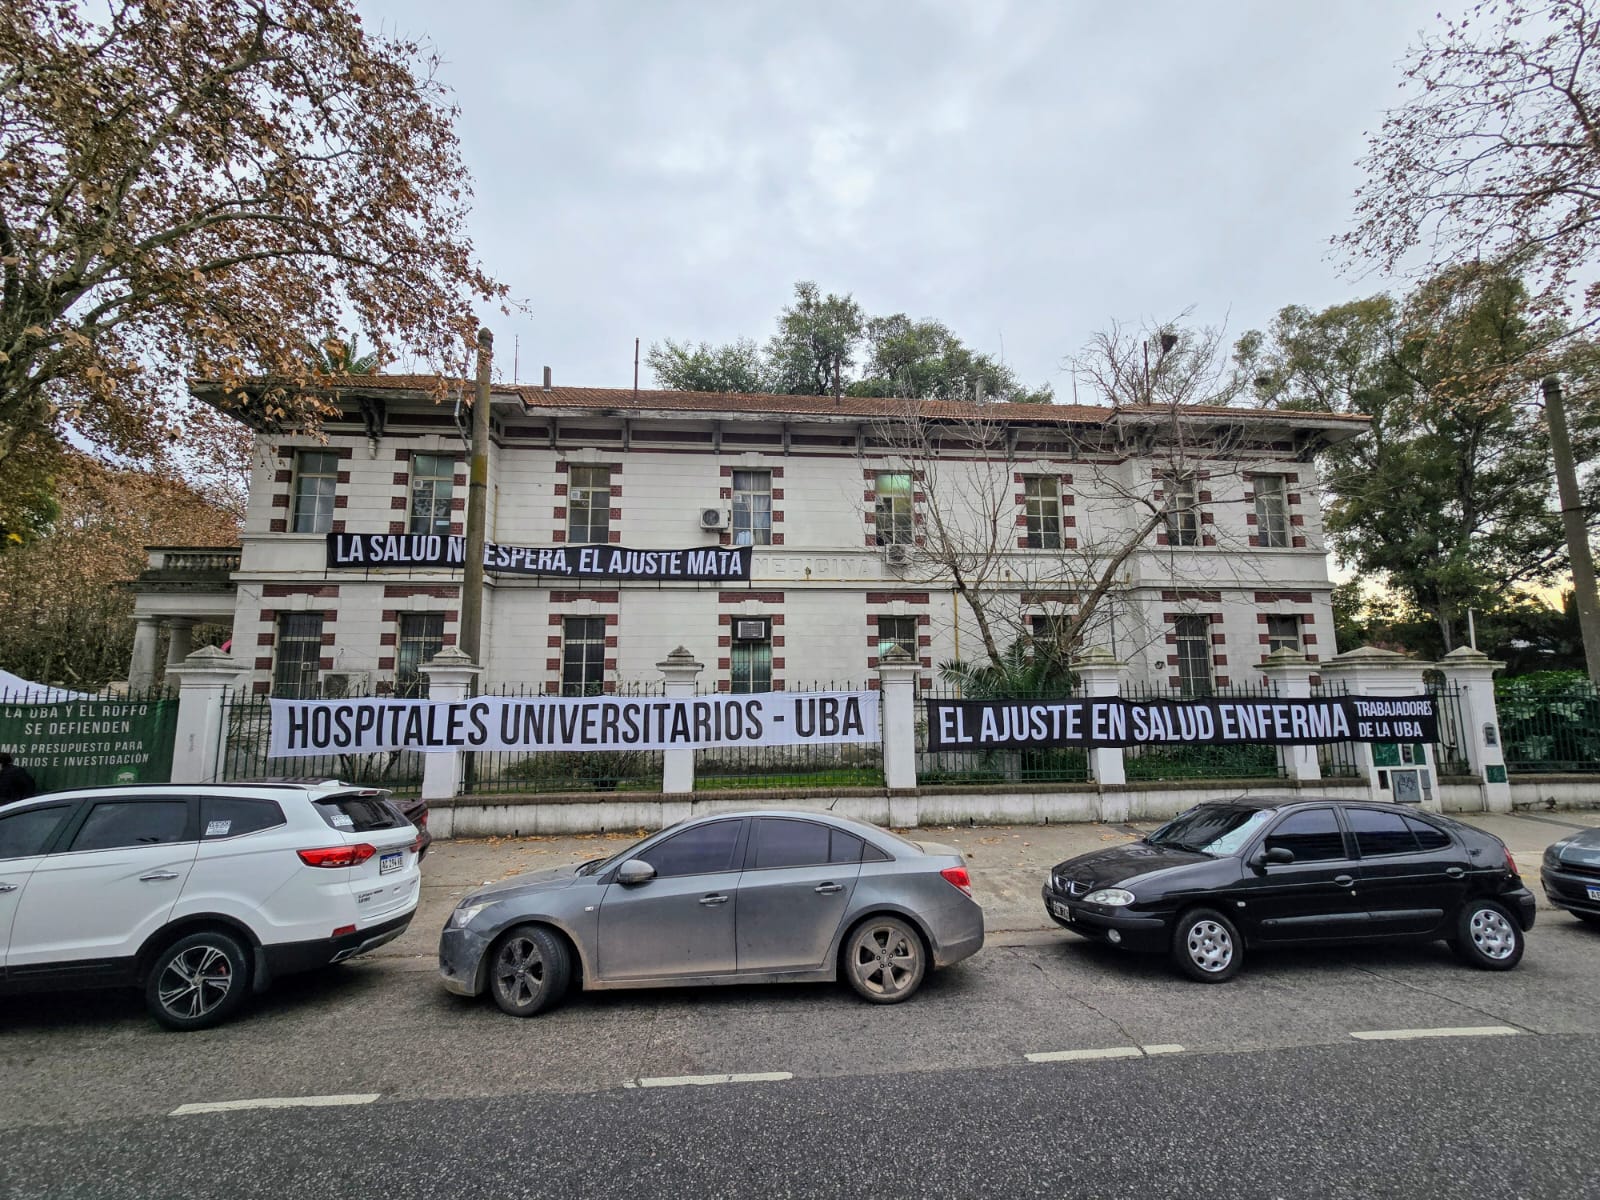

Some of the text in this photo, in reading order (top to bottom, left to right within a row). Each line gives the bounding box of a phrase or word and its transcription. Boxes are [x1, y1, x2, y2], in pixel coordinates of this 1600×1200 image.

[337, 535, 743, 576] LA SALUD N ESPERA, EL AJUSTE MATA
[5, 704, 148, 719] LA UBA Y EL ROFFO
[1353, 700, 1434, 718] TRABAJADORES
[24, 721, 131, 736] SE DEFIENDEN
[288, 702, 489, 750] HOSPITALES
[499, 700, 764, 746] UNIVERSITARIOS
[795, 696, 866, 737] UBA
[938, 703, 1352, 744] EL AJUSTE EN SALUD ENFERMA
[1358, 721, 1424, 738] DE LA UBA
[31, 741, 110, 754] PRESUPUESTO
[115, 740, 143, 751] PARA
[53, 756, 60, 767] E
[64, 752, 150, 767] INVESTIGACIÓN
